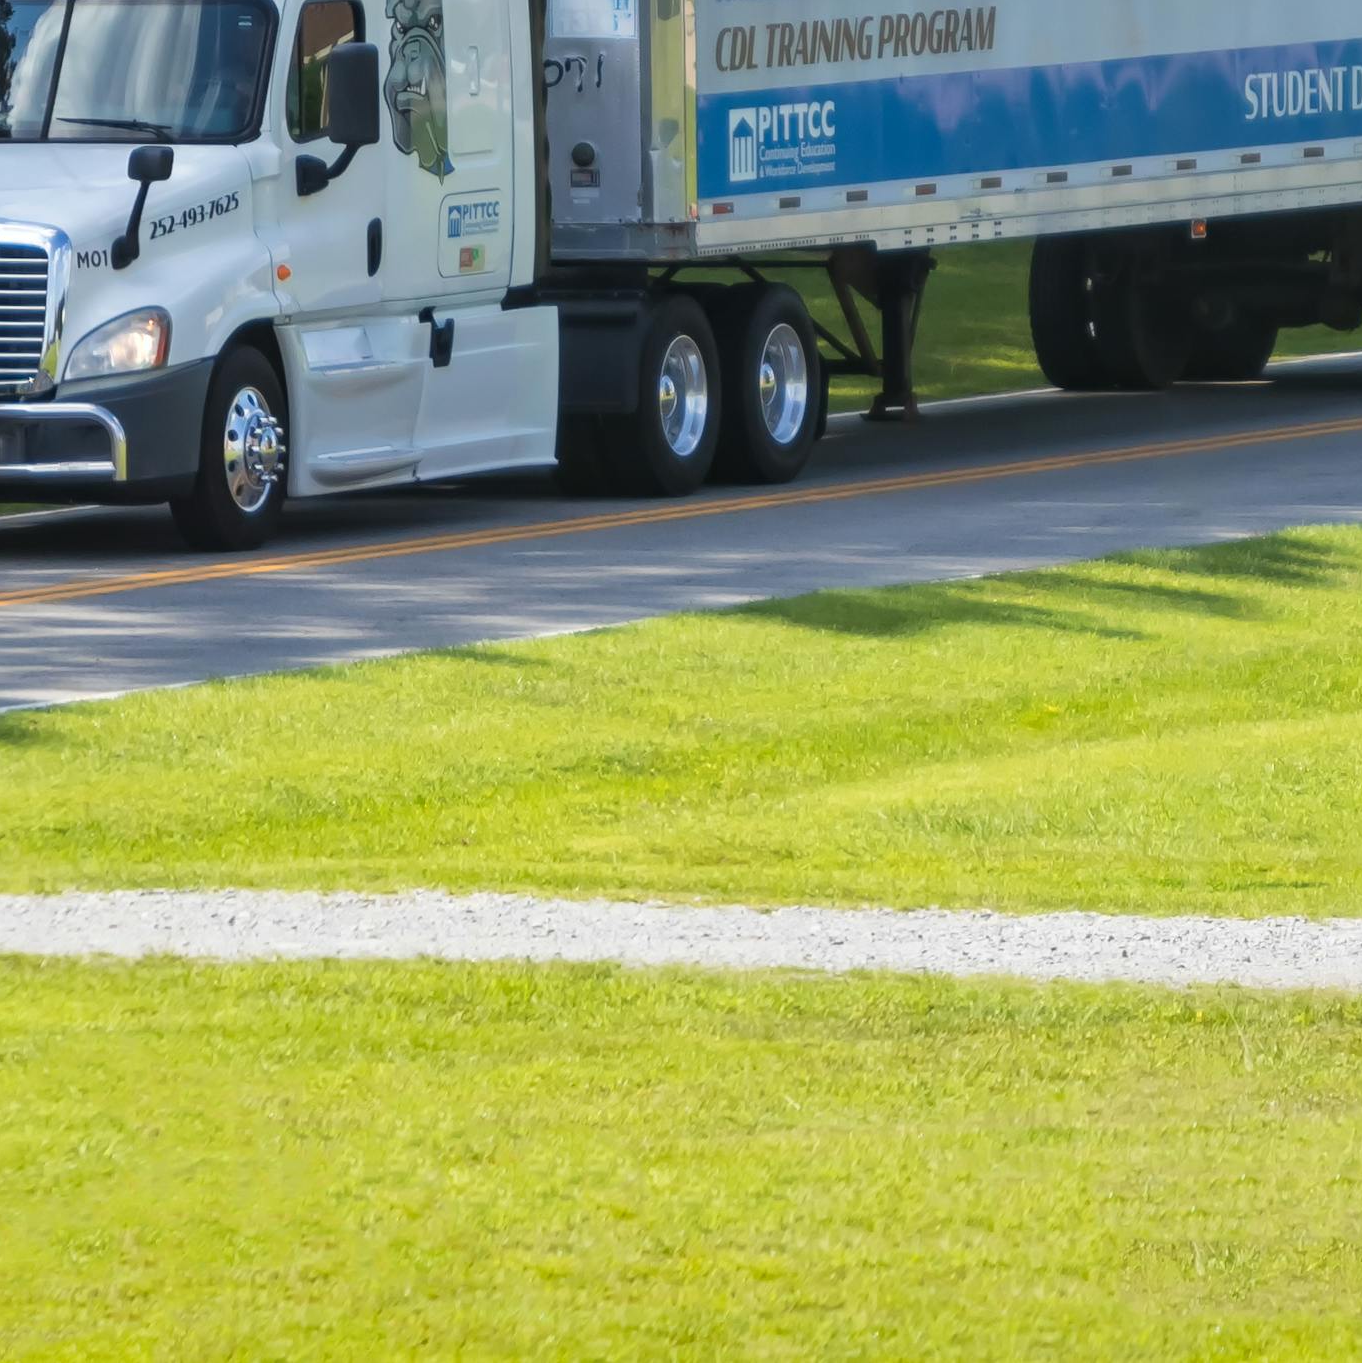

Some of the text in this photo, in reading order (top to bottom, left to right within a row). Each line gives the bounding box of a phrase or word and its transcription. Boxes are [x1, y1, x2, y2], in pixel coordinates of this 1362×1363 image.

[715, 5, 997, 73] CDL TRAINING PROGRAM
[1244, 65, 1346, 120] STUDENT
[758, 100, 836, 143] PITTCC
[149, 191, 240, 240] 252-493-7625
[462, 201, 500, 220] PITTCC
